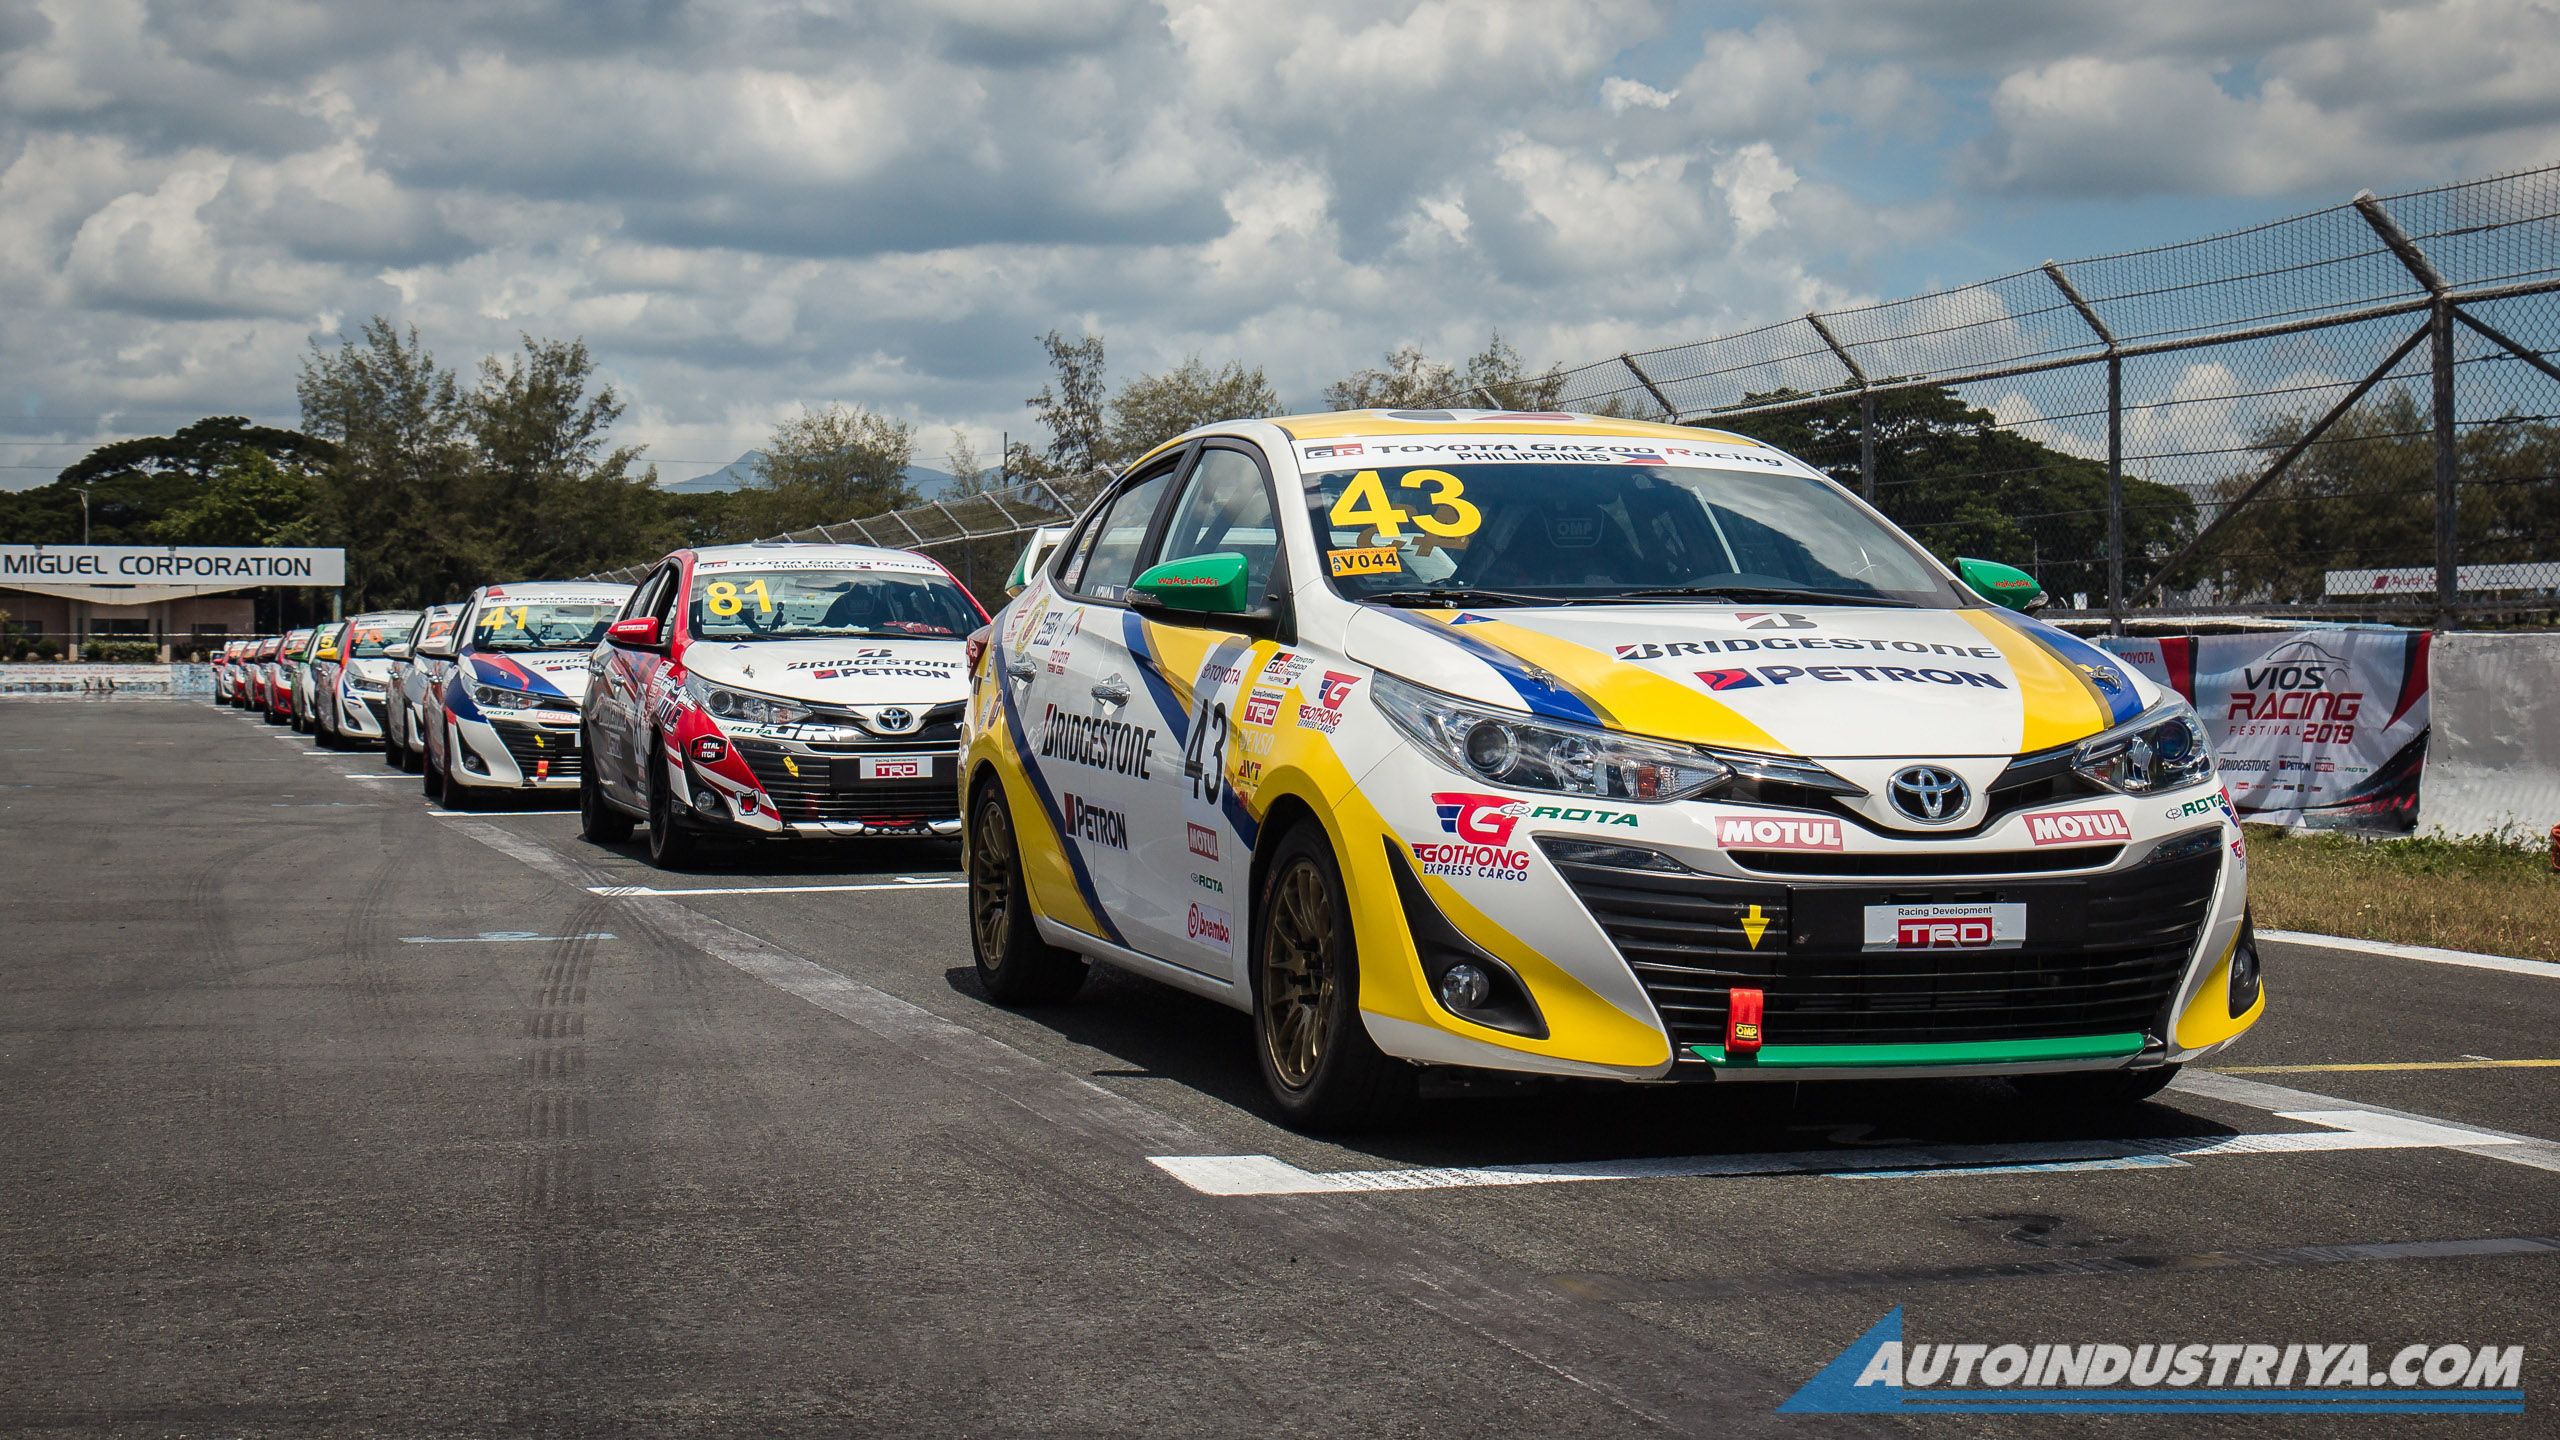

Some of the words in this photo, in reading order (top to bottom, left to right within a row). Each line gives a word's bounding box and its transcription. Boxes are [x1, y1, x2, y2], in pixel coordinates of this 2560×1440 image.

[1372, 444, 1526, 454] TOYOTA
[1531, 443, 1655, 453] GAZOO
[1665, 447, 1783, 467] Racing
[1458, 452, 1611, 463] PHILIPPINES
[1329, 469, 1482, 538] 43
[4, 554, 108, 575] MIGUEL
[119, 556, 312, 577] CORPORATION
[876, 561, 936, 571] Racing
[1341, 553, 1397, 569] V044
[1158, 575, 1218, 586] waku-doki
[706, 579, 774, 617] 81
[480, 605, 529, 631] 41
[353, 629, 382, 644] 76
[1293, 655, 1316, 664] TOYOTA
[1616, 638, 2002, 660] BRIDGESTONE
[2120, 651, 2156, 665] TOYOTA
[787, 659, 963, 671] BRIDGESTONE
[843, 668, 951, 679] PETRON
[1208, 664, 1241, 686] TOYOTA
[1282, 668, 1302, 679] Racing
[1287, 662, 1307, 670] GAZOO
[1757, 665, 2009, 690] PETRON
[2244, 667, 2326, 690] VIOS
[537, 712, 573, 720] MOTUL
[1249, 702, 1277, 726] TRD
[1299, 704, 1343, 727] GOTHONG
[2228, 692, 2363, 721] RACING
[731, 726, 772, 735] ROTA
[1297, 720, 1318, 729] EXPRESS
[1317, 723, 1336, 734] CARGO
[2229, 724, 2301, 736] FESTIVAL
[2302, 723, 2354, 744] 2019
[1042, 703, 1157, 780] BRIDGESTONE
[1184, 699, 1228, 805] 43
[1239, 729, 1275, 756] DENSO
[877, 765, 916, 776] TRD
[2218, 758, 2271, 772] BRIDGESTONE
[2286, 761, 2311, 772] PETRON
[2315, 763, 2334, 771] MOTUL
[2183, 792, 2228, 817] ROTA
[1075, 796, 1128, 851] PETRON
[1531, 806, 1639, 828] ROTA
[2034, 813, 2129, 841] MOTUL
[1189, 826, 1218, 857] MOTUL
[1721, 820, 1842, 846] MOTUL
[1411, 843, 1530, 870] GOTHONG
[1424, 863, 1472, 877] EXPRESS
[1478, 867, 1528, 882] CARGO
[1199, 874, 1224, 894] ROTA
[1898, 907, 1930, 917] Racing
[1932, 905, 1992, 916] Development
[1200, 913, 1231, 944] brembo
[1900, 923, 1989, 948] TRD
[1736, 1025, 1758, 1037] OMP
